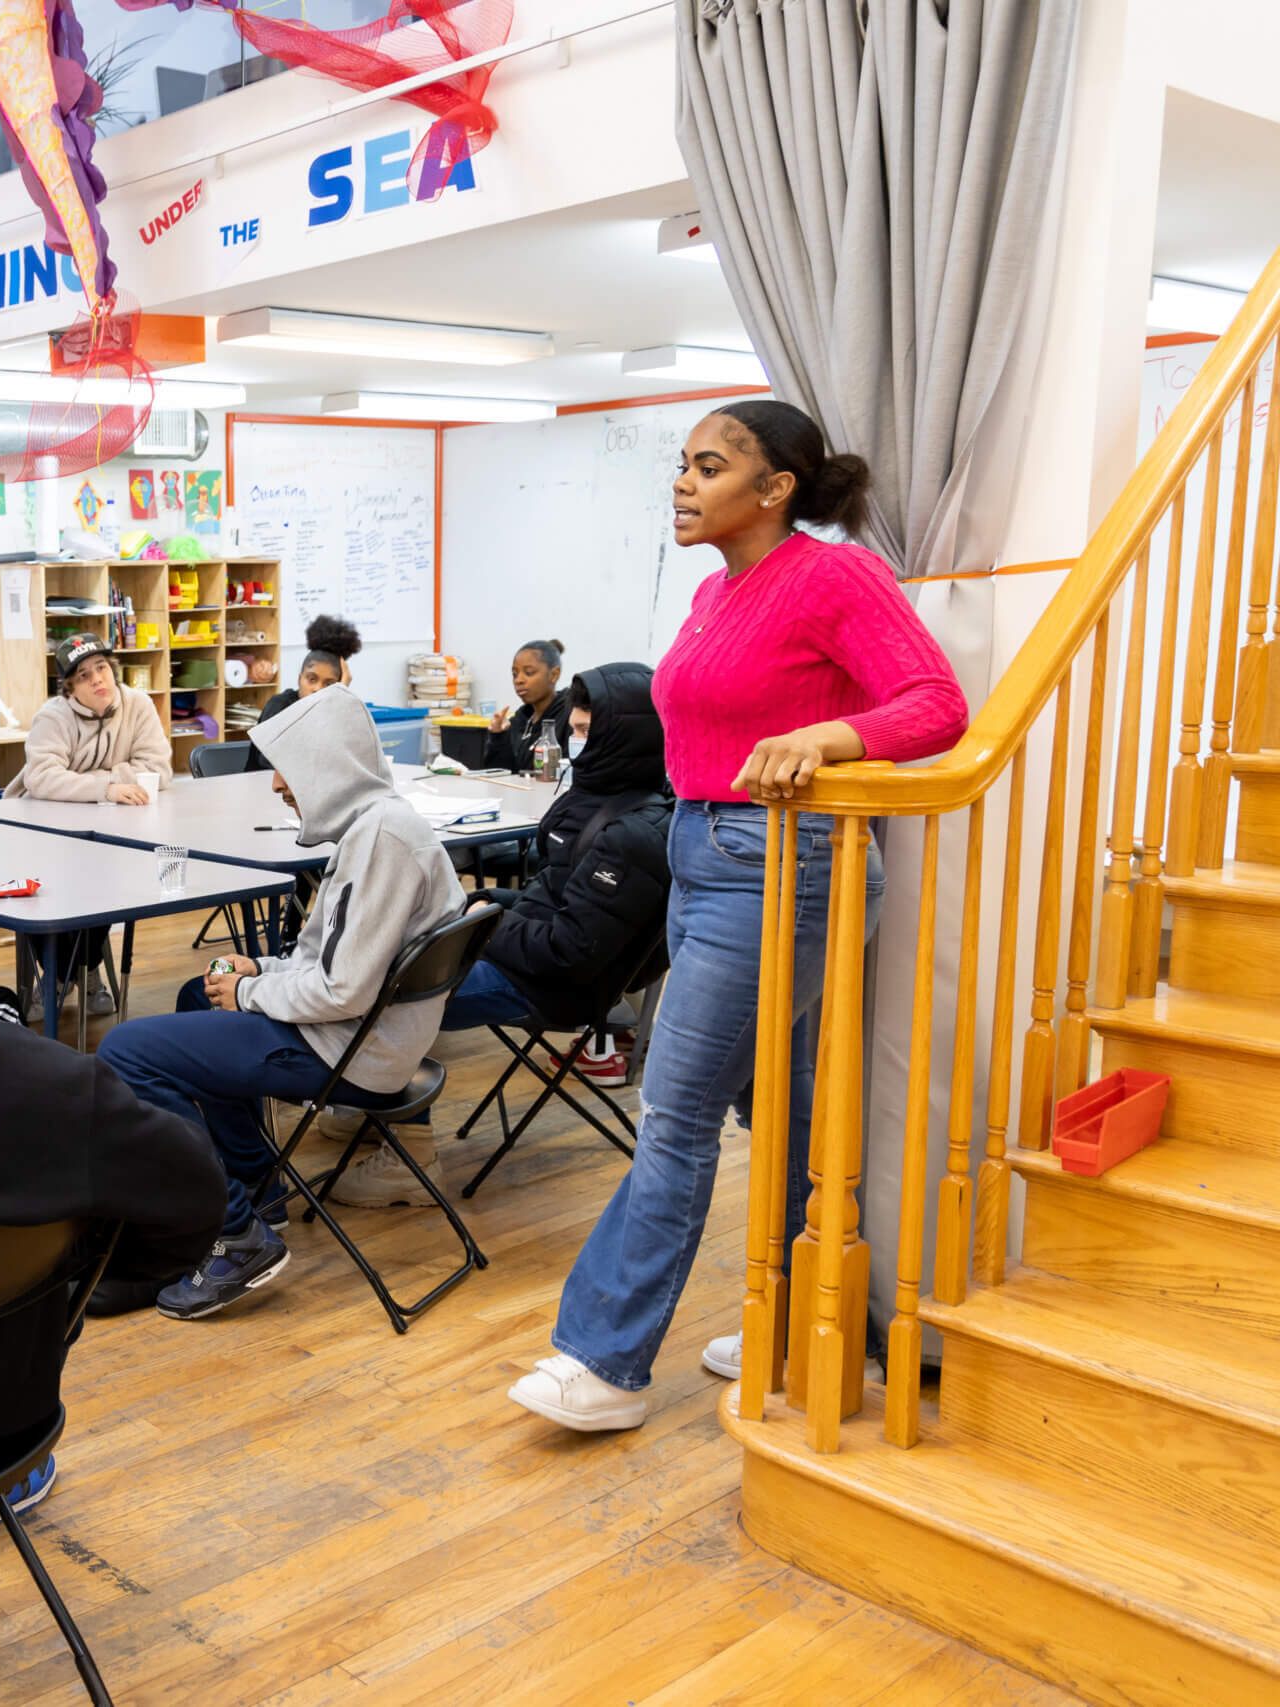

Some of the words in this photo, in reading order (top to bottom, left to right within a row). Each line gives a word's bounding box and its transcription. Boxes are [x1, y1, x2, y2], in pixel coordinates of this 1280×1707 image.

[138, 178, 203, 245] UNDER
[219, 218, 260, 247] THE
[308, 120, 476, 227] SEA
